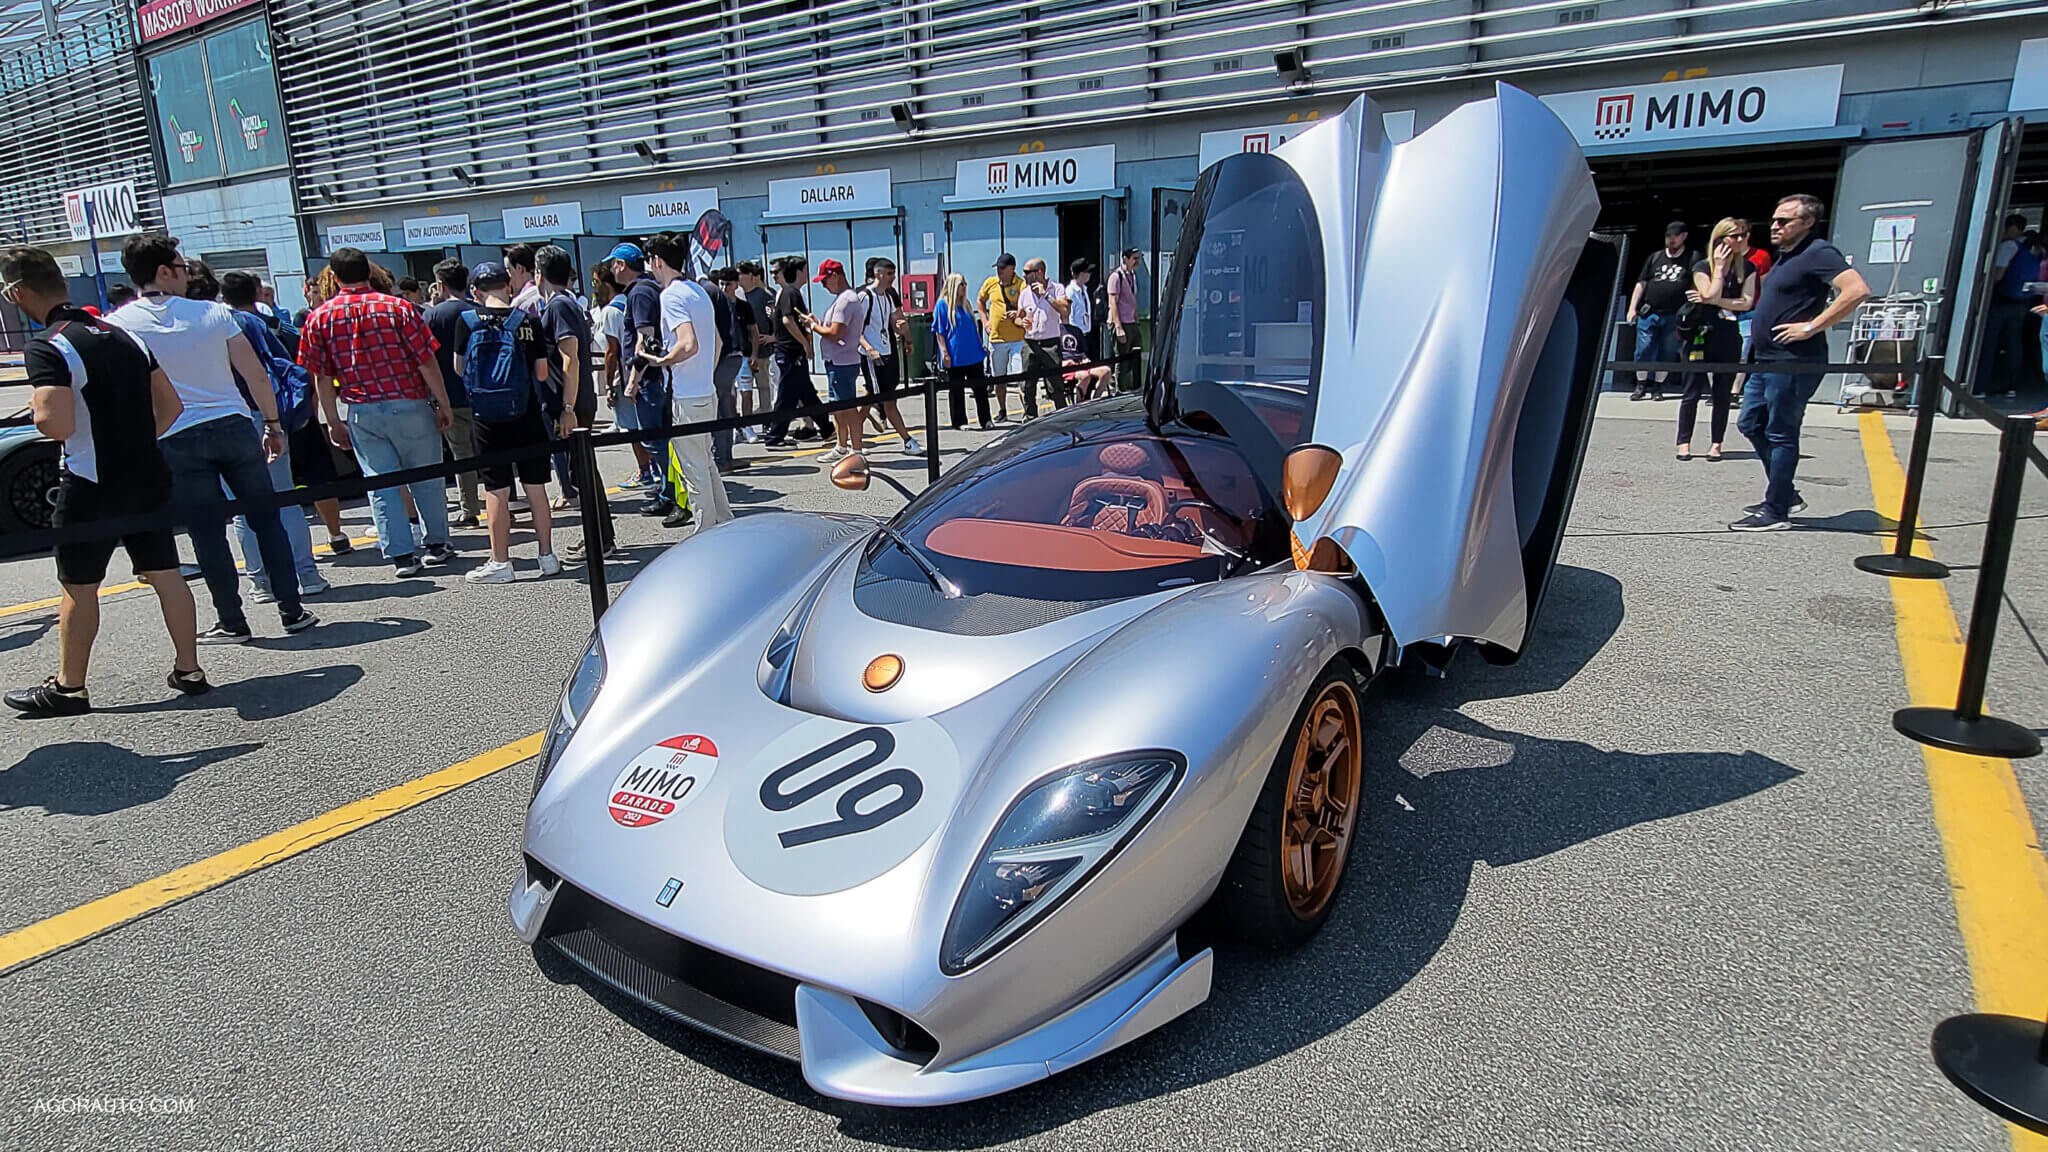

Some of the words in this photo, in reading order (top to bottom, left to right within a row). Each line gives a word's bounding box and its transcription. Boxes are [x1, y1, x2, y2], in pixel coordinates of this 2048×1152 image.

[1645, 86, 1766, 131] MIMO
[1015, 158, 1077, 189] MIMO
[801, 185, 855, 204] DALLARA
[83, 185, 135, 233] MIMO
[648, 202, 691, 217] DALLARA
[408, 227, 421, 239] INDY
[423, 223, 466, 237] AUTONOMOUS
[524, 214, 560, 229] DALLARA
[343, 231, 382, 244] AUTONOMOUS
[620, 765, 696, 800] MIMO
[759, 726, 924, 849] 09
[618, 794, 668, 813] PARADE
